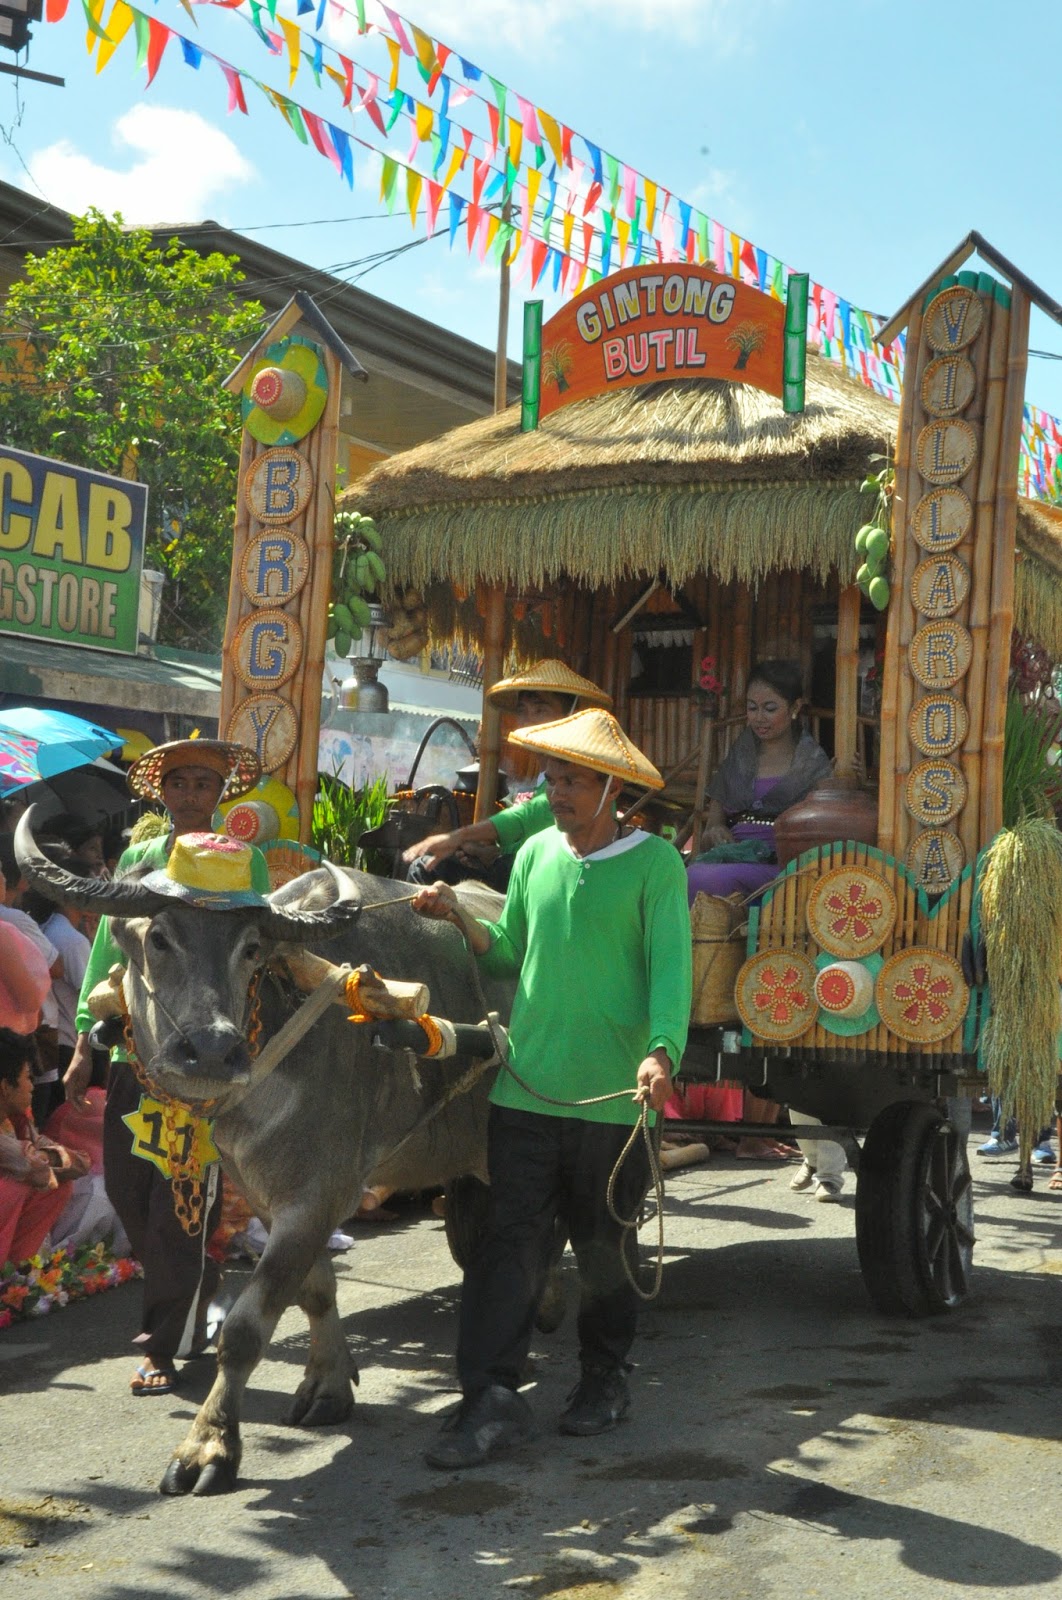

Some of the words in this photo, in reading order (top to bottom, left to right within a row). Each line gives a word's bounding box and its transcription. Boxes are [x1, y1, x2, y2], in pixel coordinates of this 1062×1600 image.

[576, 274, 736, 343] GINTONG
[602, 328, 707, 381] BUTIL
[245, 457, 301, 770] BRGY
[918, 295, 973, 884] VILLAROSA
[138, 1110, 195, 1167] 11
